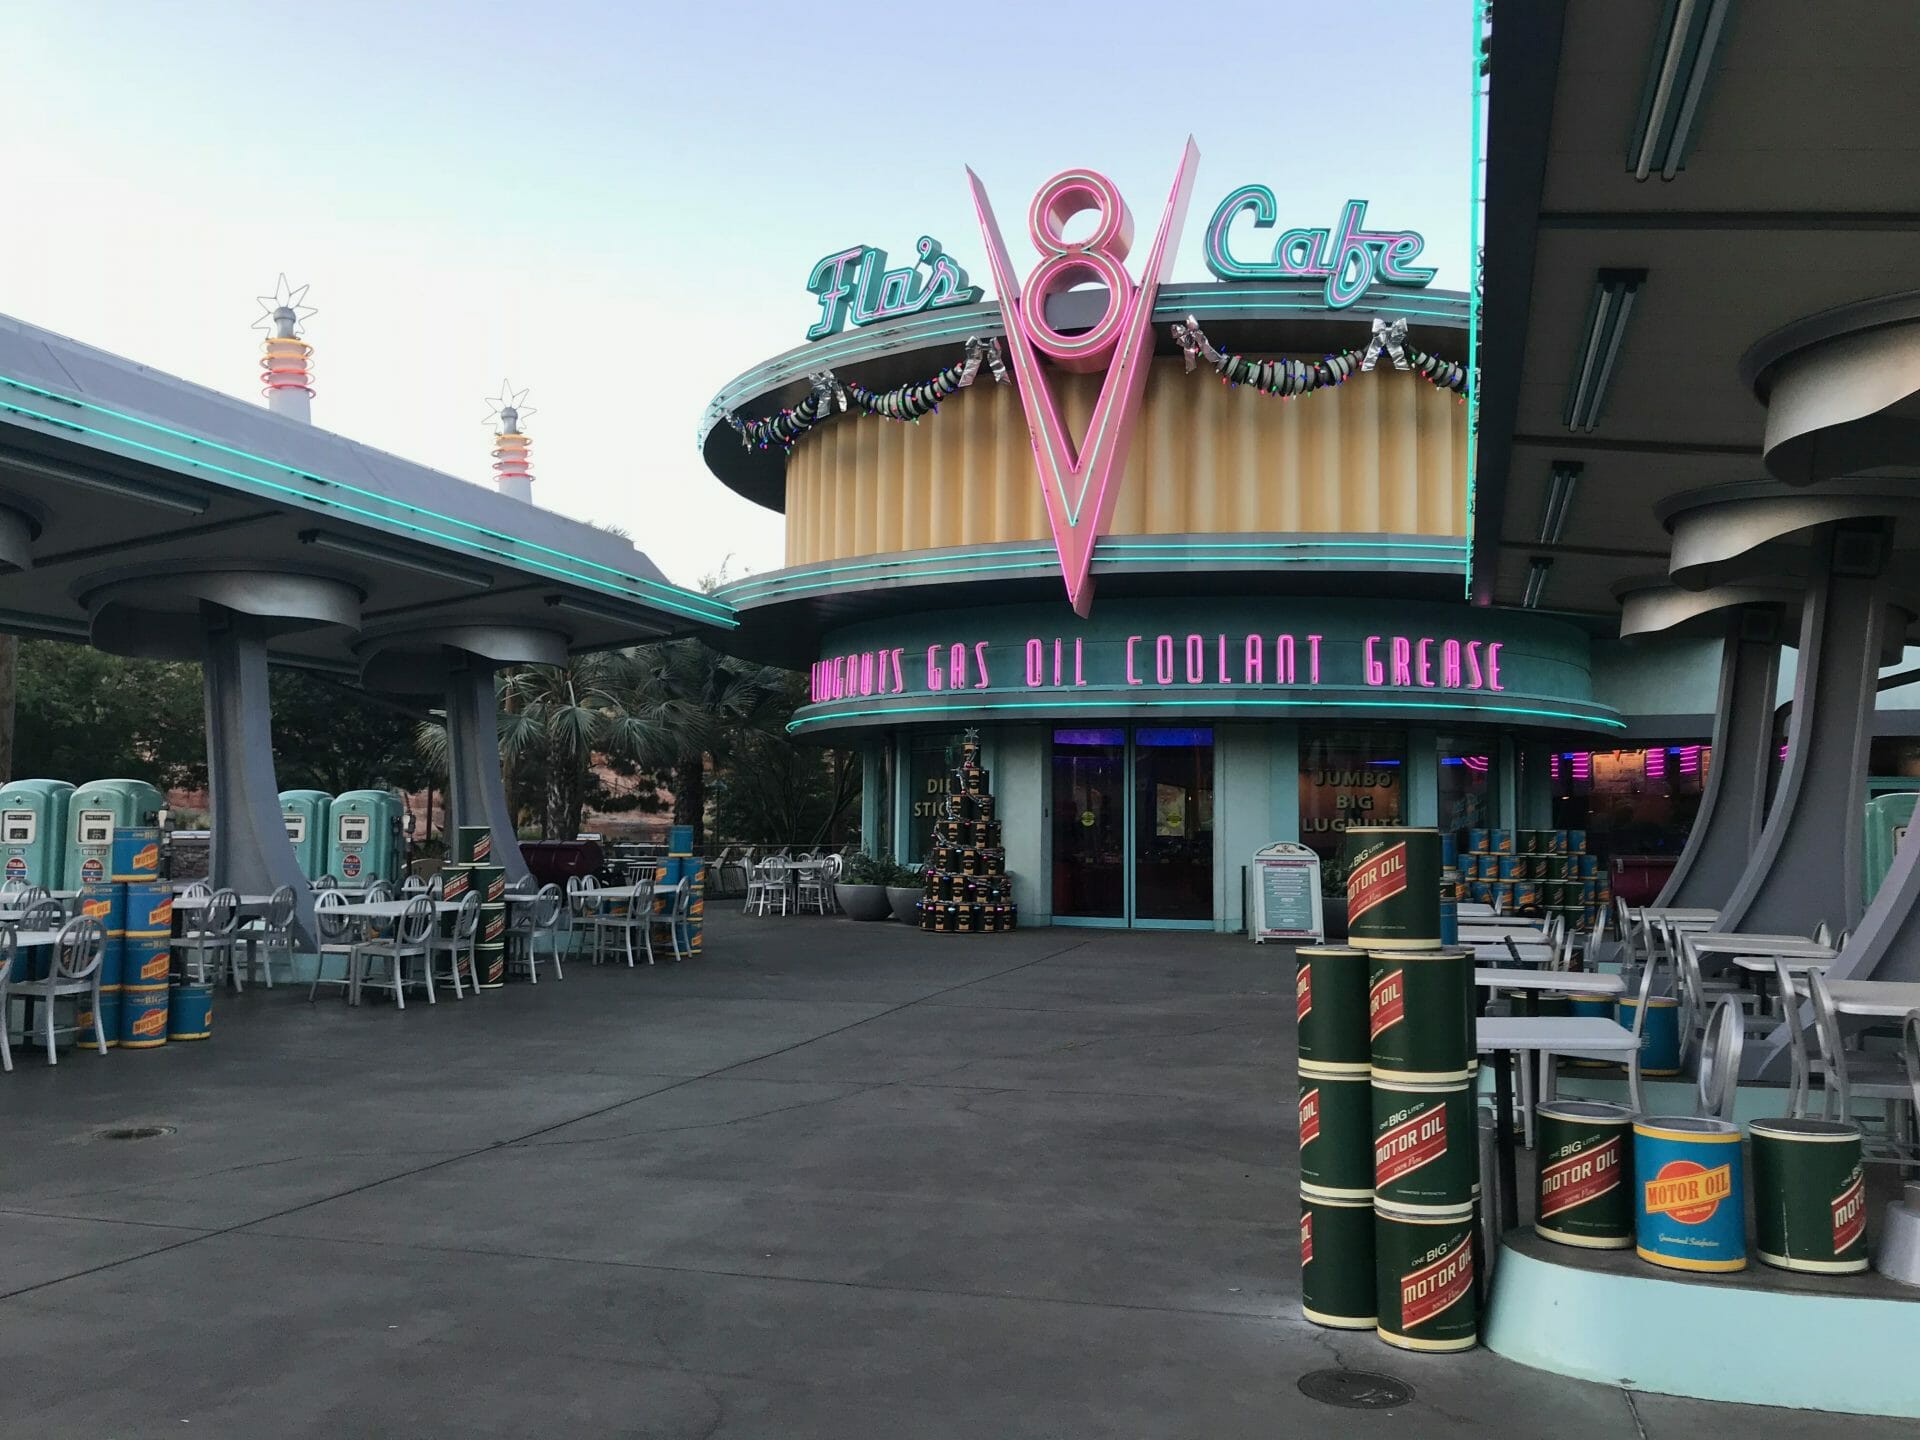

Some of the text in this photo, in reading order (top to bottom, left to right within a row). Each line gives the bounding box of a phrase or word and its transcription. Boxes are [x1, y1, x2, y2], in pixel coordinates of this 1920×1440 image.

[806, 235, 985, 341] Flo's
[1206, 183, 1438, 310] Cafe
[811, 634, 1504, 704] LUGNUTS GAS OIL COOLANT GREASE
[1316, 771, 1391, 787] JUMBO
[1336, 794, 1373, 809] BIG
[1353, 849, 1369, 867] BIG
[1381, 855, 1404, 878] OIL
[1381, 984, 1401, 1006] OIL
[1303, 1101, 1317, 1123] OIL
[1389, 1109, 1408, 1127] BIG
[1376, 1117, 1445, 1167] MOTOR OIL
[1561, 1141, 1582, 1157] BIG
[1543, 1149, 1618, 1196] MOTOR OIL
[1648, 1172, 1729, 1206] MOTOR OIL
[1411, 1256, 1425, 1267] ONE
[1427, 1243, 1447, 1262] BIG
[1404, 1245, 1472, 1305] MOTOR OIL
